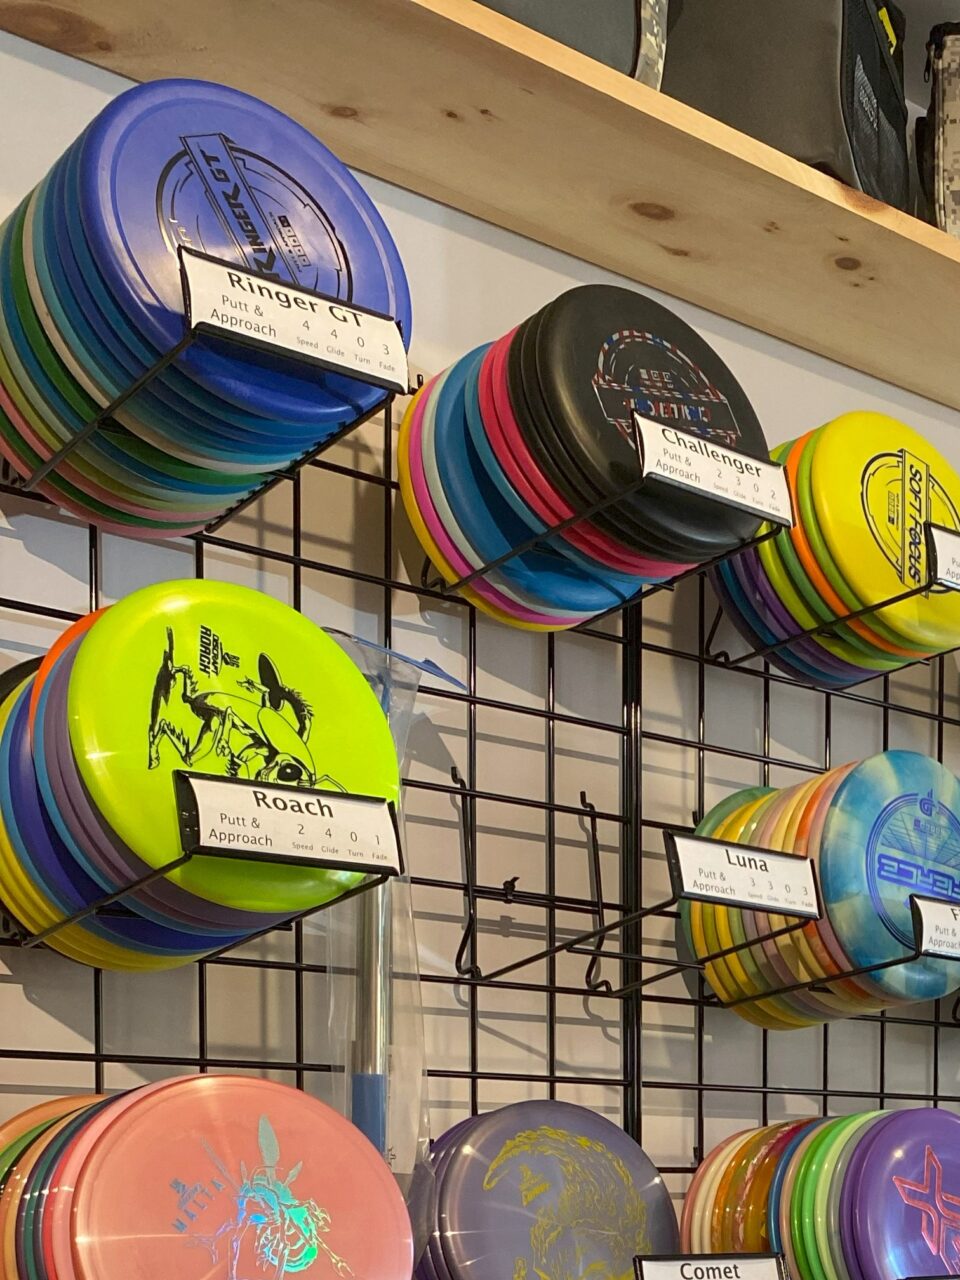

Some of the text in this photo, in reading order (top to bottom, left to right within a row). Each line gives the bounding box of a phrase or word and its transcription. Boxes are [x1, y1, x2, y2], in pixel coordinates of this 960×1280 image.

[222, 295, 264, 317] Putt &
[227, 272, 362, 327] Ringer GT
[211, 309, 276, 338] Approach
[297, 337, 396, 372] Speed Glide Turn Fade
[662, 428, 762, 478] Challenger
[663, 448, 681, 463] Putt
[656, 459, 700, 483] Approach
[909, 464, 922, 583] SOFT FOCUS
[199, 625, 211, 675] ROACH
[252, 791, 334, 818] Roach
[220, 813, 245, 827] Putt
[209, 830, 272, 847] Approach
[292, 842, 314, 852] Speed
[725, 849, 769, 872] Luna
[699, 868, 716, 880] Putt
[693, 880, 736, 895] Approach
[935, 925, 950, 935] Putt
[680, 1263, 741, 1280] Comet
